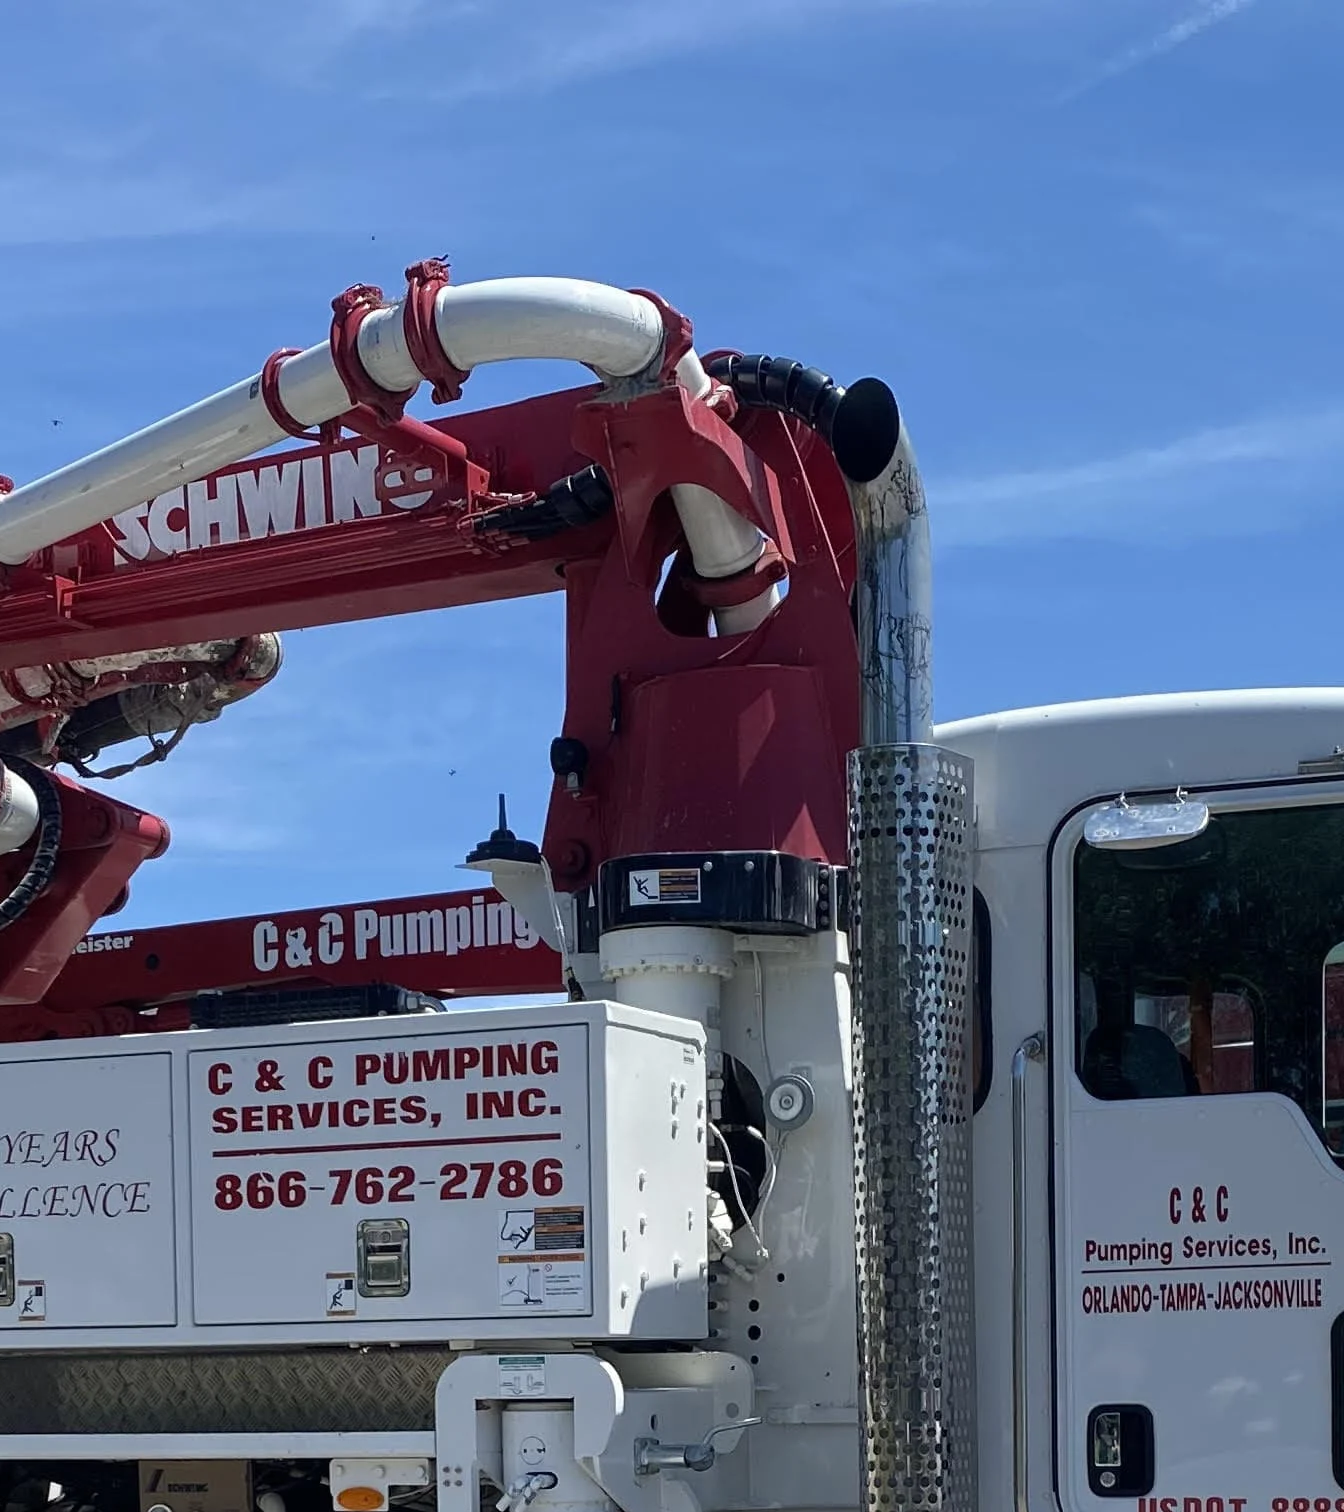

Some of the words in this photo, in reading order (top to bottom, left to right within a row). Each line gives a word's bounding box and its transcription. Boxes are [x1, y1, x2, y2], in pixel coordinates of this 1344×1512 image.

[71, 934, 134, 955] eister
[253, 919, 279, 972] C
[285, 926, 312, 968] &
[318, 912, 344, 965] C
[354, 896, 543, 961] Pumping
[208, 1064, 230, 1095] C
[255, 1061, 281, 1092] &
[308, 1056, 332, 1089] C
[355, 1041, 559, 1085] PUMPING
[211, 1095, 443, 1133] SERVICES,
[466, 1088, 561, 1119] INC.
[214, 1159, 562, 1211] 866-762-2786
[1169, 1186, 1182, 1225] C
[1191, 1185, 1207, 1224] &
[1216, 1184, 1229, 1223] C
[1084, 1238, 1173, 1266] Pumping
[1182, 1234, 1278, 1262] Services,
[1288, 1231, 1327, 1256] Inc.
[1081, 1278, 1323, 1315] ORLANDO-TAMPA-JACKSONVILLE
